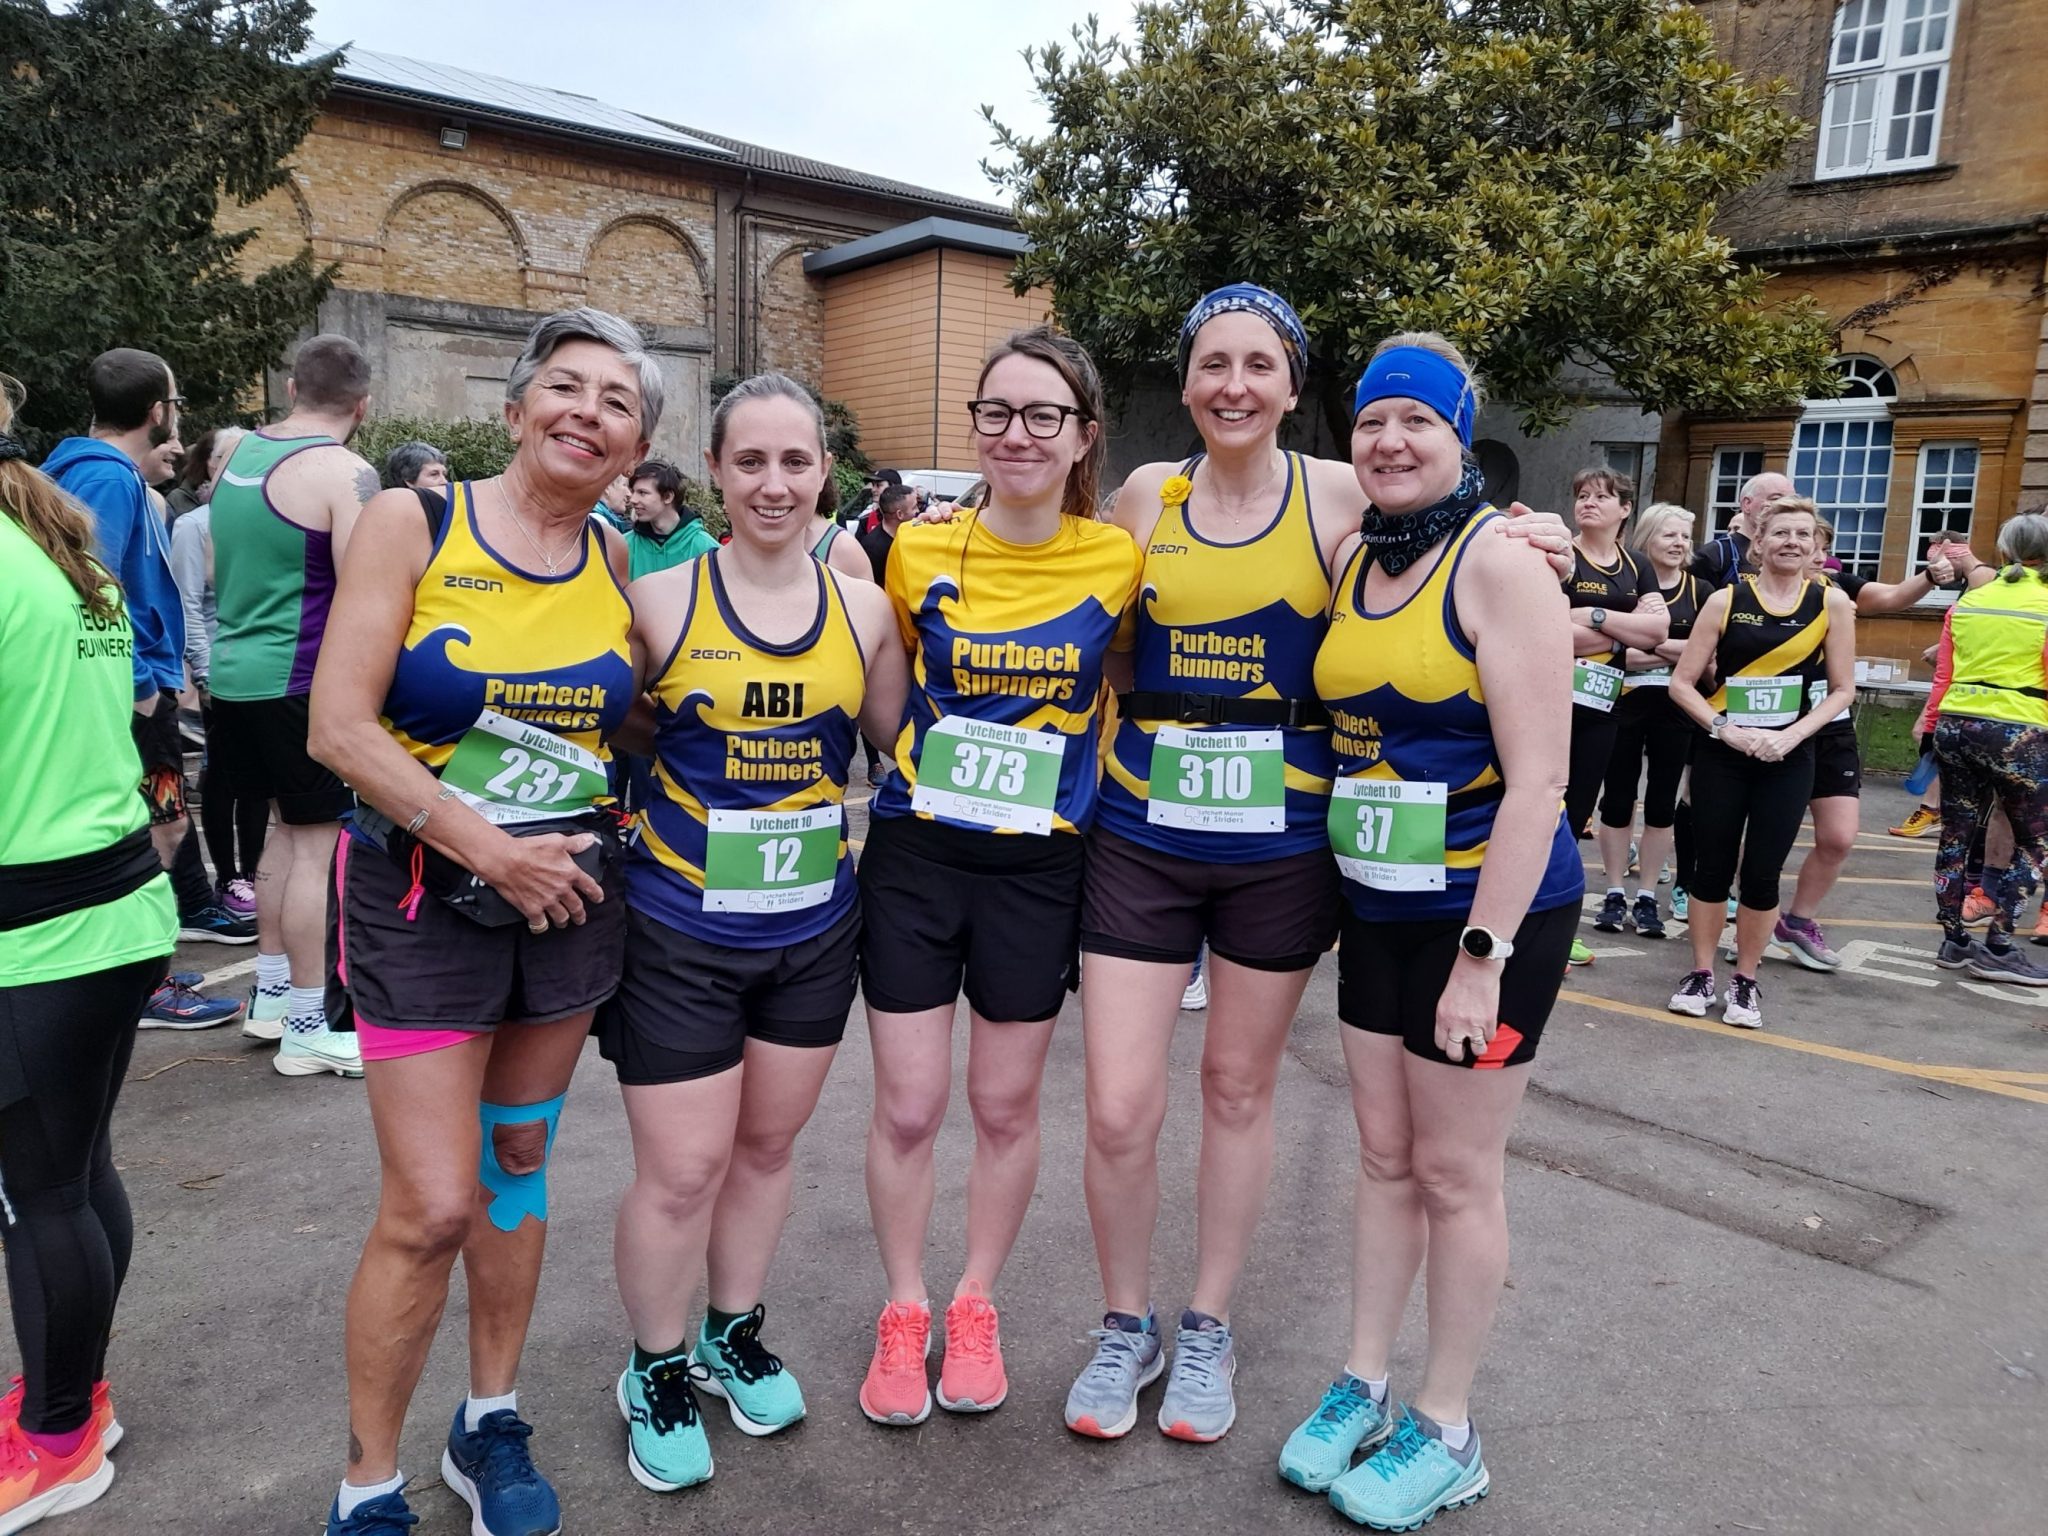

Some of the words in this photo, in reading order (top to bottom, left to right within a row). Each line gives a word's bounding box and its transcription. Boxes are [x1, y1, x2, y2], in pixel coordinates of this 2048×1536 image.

[952, 637, 1082, 672] Purbeck
[1170, 629, 1266, 659] Purbeck
[952, 668, 1076, 700] Runners
[1169, 654, 1265, 684] Runners
[1583, 671, 1615, 697] 355
[485, 679, 607, 709] Purbeck
[741, 681, 804, 718] ABI
[1744, 688, 1783, 711] 157
[519, 729, 567, 757] Lytchett
[568, 746, 579, 762] 10
[726, 735, 822, 760] Purbeck
[965, 722, 1012, 743] Lytchett
[1015, 732, 1027, 745] 10
[1185, 734, 1232, 749] Lytchett
[1234, 735, 1247, 748] 10
[484, 747, 580, 805] 231
[725, 757, 823, 781] Runners
[950, 742, 1028, 796] 373
[1178, 754, 1252, 800] 310
[1353, 782, 1386, 799] Lytchett
[1388, 785, 1401, 799] 10
[750, 817, 799, 831] Lytchett
[801, 816, 812, 830] 10
[1214, 816, 1243, 824] Striders
[1356, 804, 1393, 854] 37
[758, 836, 803, 882] 12
